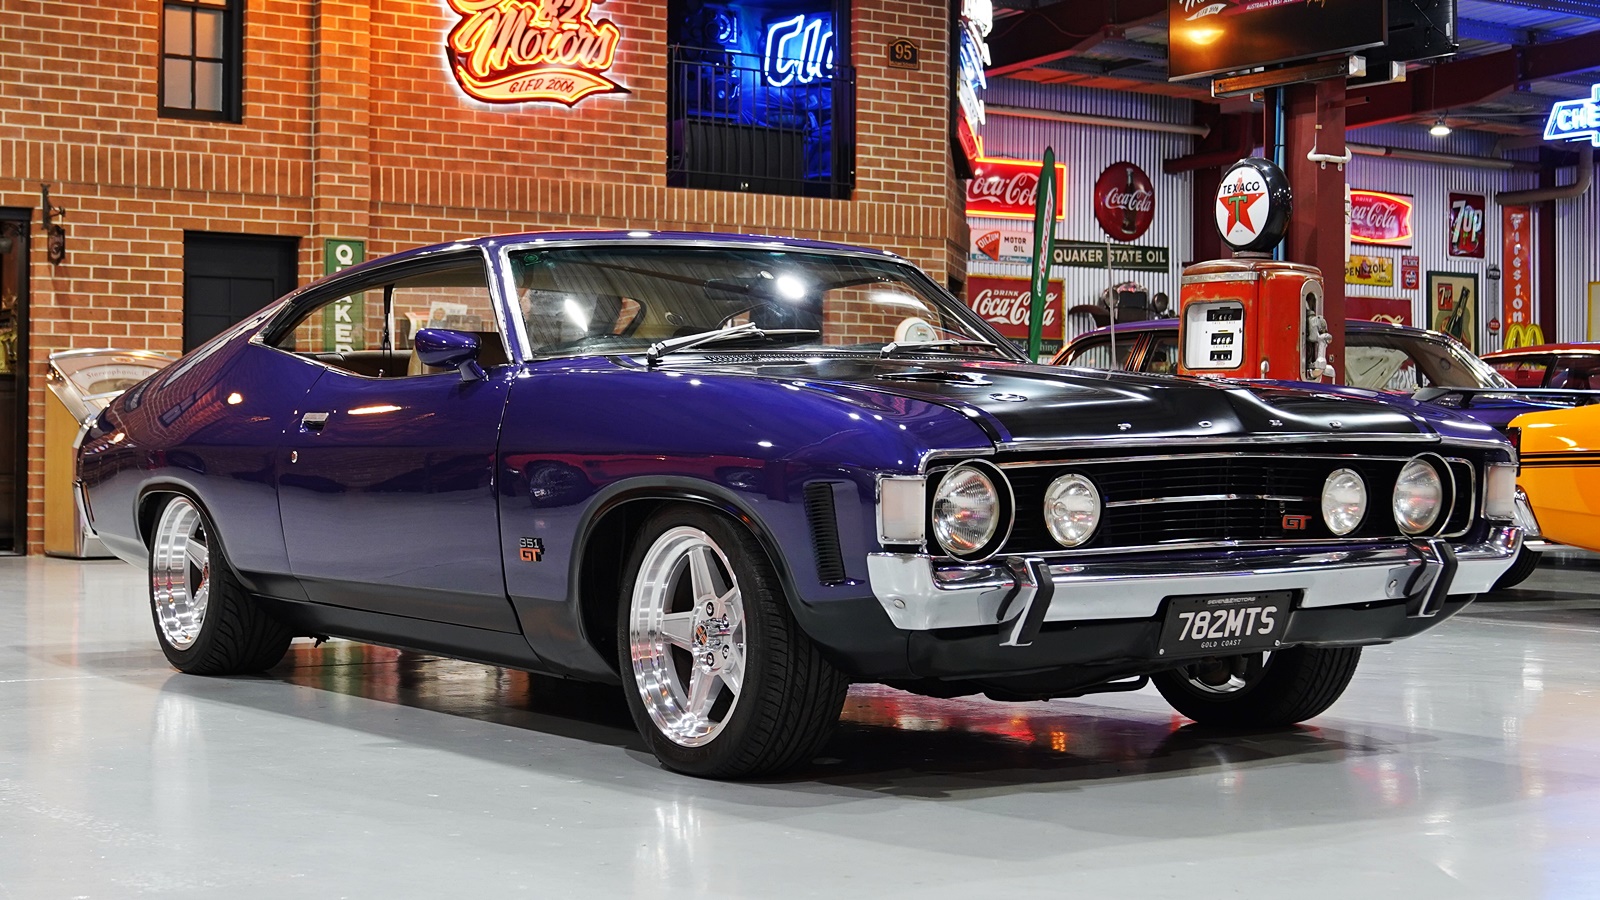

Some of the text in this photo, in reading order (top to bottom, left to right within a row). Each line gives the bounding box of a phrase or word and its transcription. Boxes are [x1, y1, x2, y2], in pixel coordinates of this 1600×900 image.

[458, 7, 610, 76] Motors
[895, 44, 912, 60] 95
[545, 79, 575, 93] 2006
[1223, 181, 1260, 195] TEXACO
[1105, 187, 1153, 212] Coca-Cola
[1004, 236, 1027, 245] MOTOR
[1013, 245, 1025, 253] OIL
[1053, 249, 1166, 263] QUAKER STATE OIL
[993, 289, 1020, 297] DRINK
[86, 369, 138, 379] Stereophonic
[1282, 514, 1312, 530] GT
[519, 537, 540, 549] 351
[519, 547, 541, 562] GT
[1178, 606, 1278, 641] 782MTS
[1200, 639, 1242, 649] GOLD COAST
